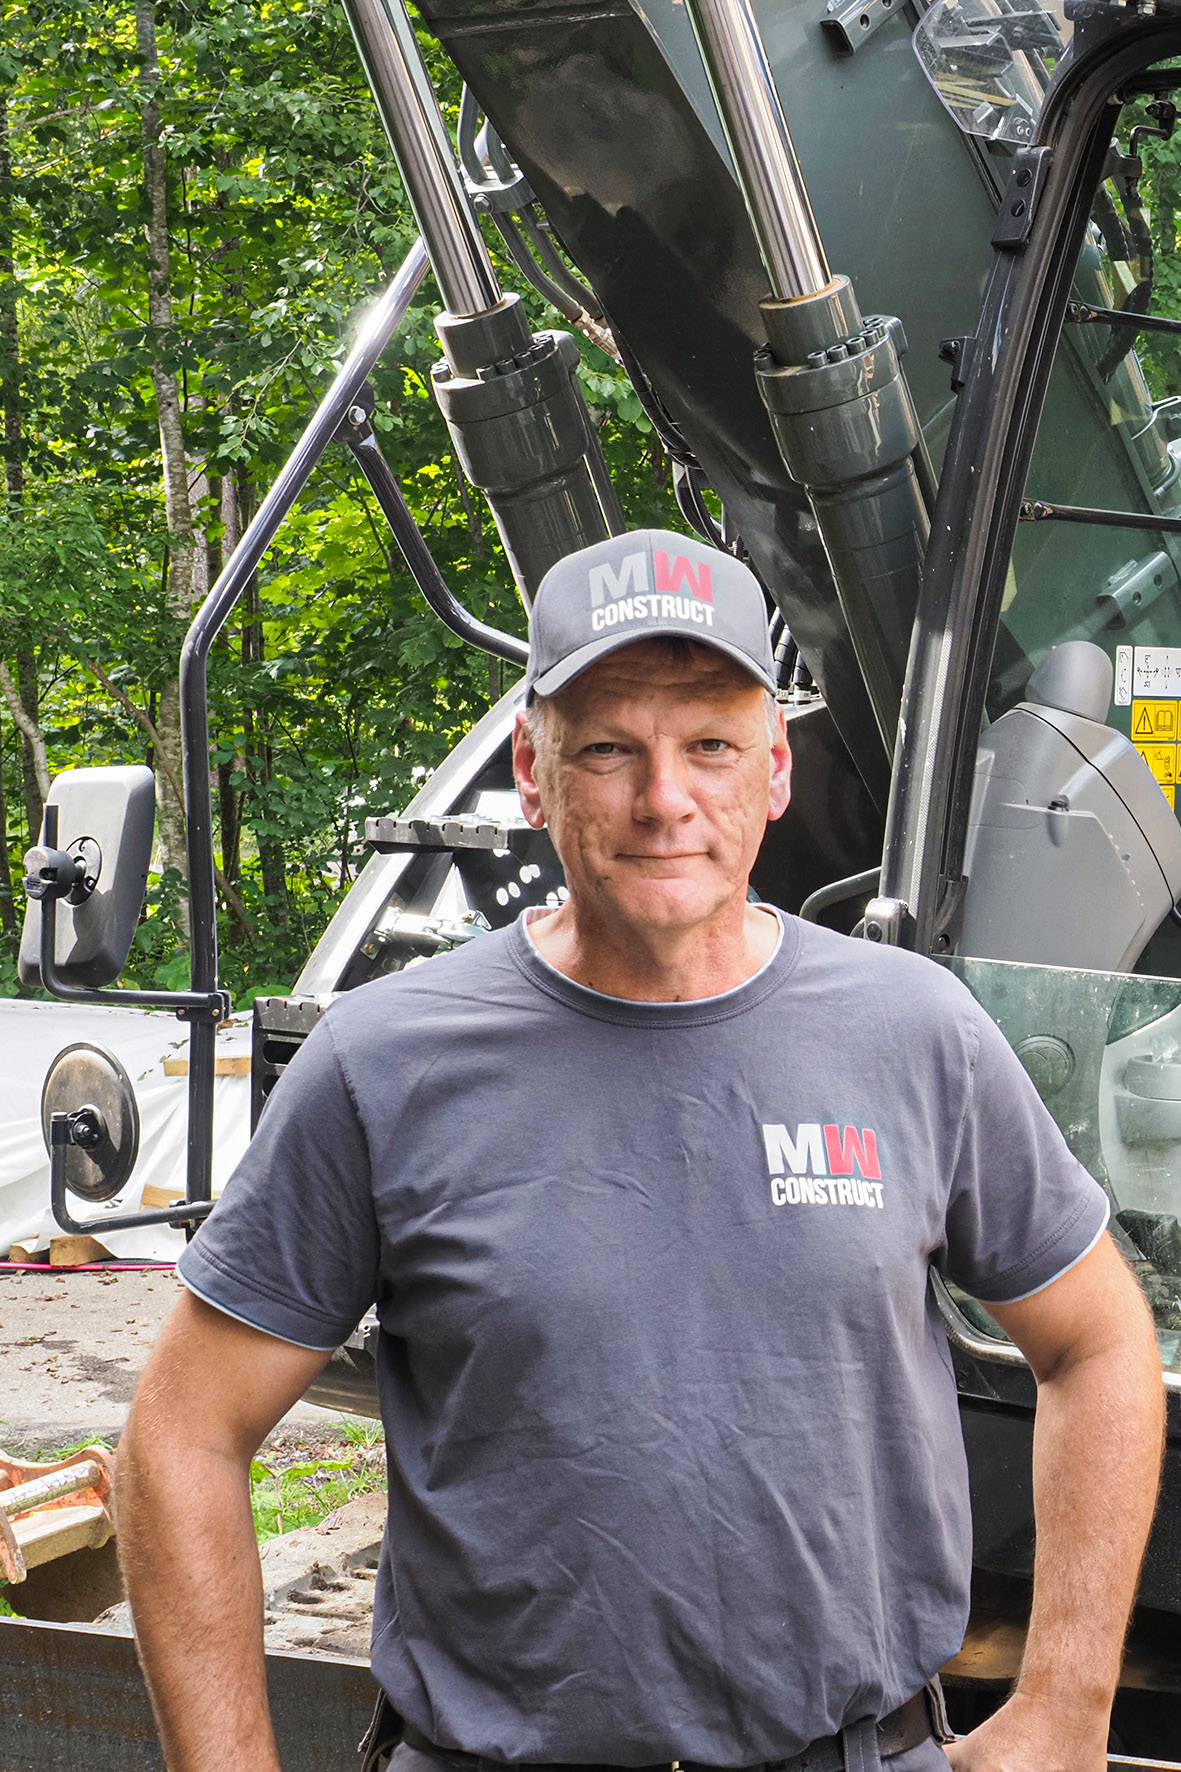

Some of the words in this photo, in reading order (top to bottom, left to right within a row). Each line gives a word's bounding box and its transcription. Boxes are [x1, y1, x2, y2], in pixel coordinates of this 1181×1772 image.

[588, 550, 714, 609] MW
[591, 595, 715, 631] CONSTRUCT
[762, 1123, 882, 1180] MW
[770, 1177, 884, 1209] CONSTRUCT
